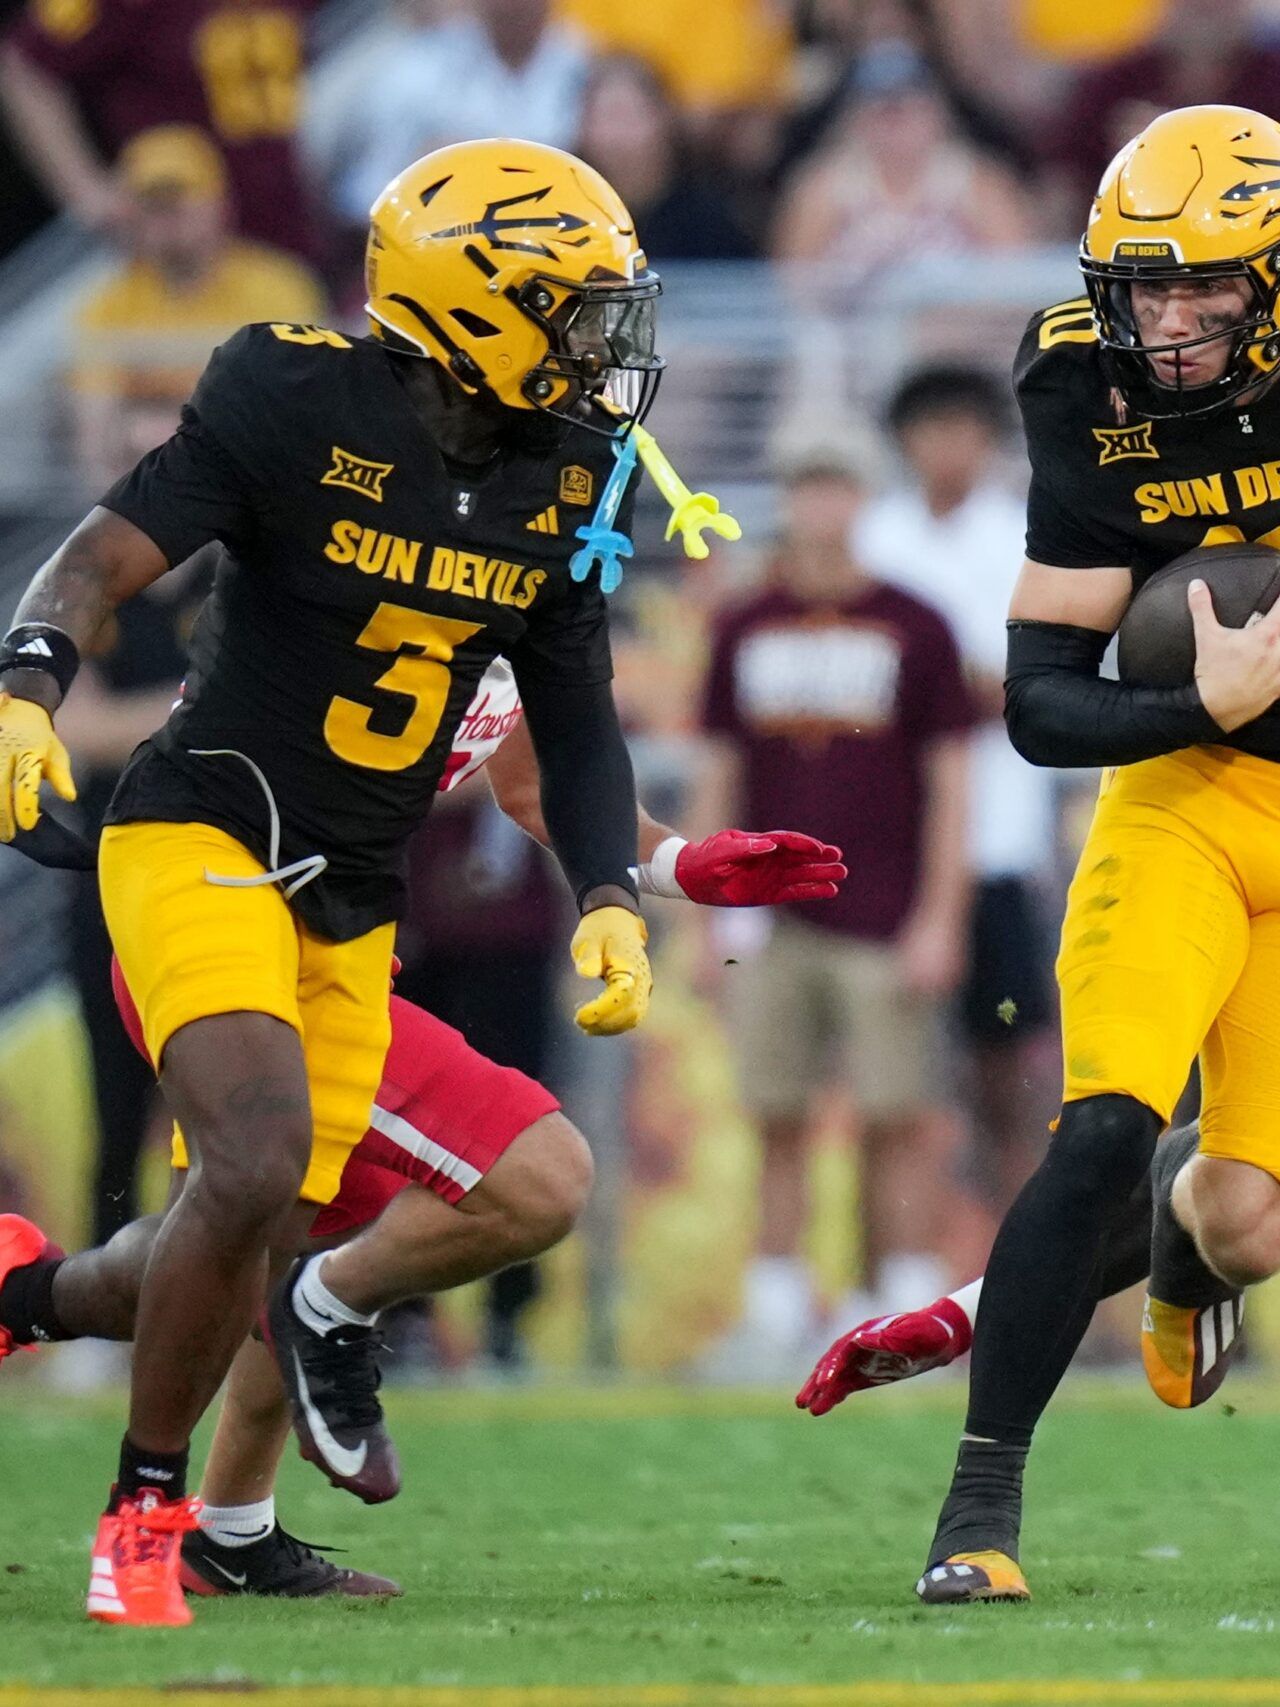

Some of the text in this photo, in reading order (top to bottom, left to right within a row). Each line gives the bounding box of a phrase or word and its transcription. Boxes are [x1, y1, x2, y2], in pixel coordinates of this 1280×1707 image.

[1119, 245, 1169, 256] SUN DEVILS
[1133, 472, 1230, 524] SUN
[324, 519, 548, 609] SUN DEVILS
[323, 601, 487, 772] 3
